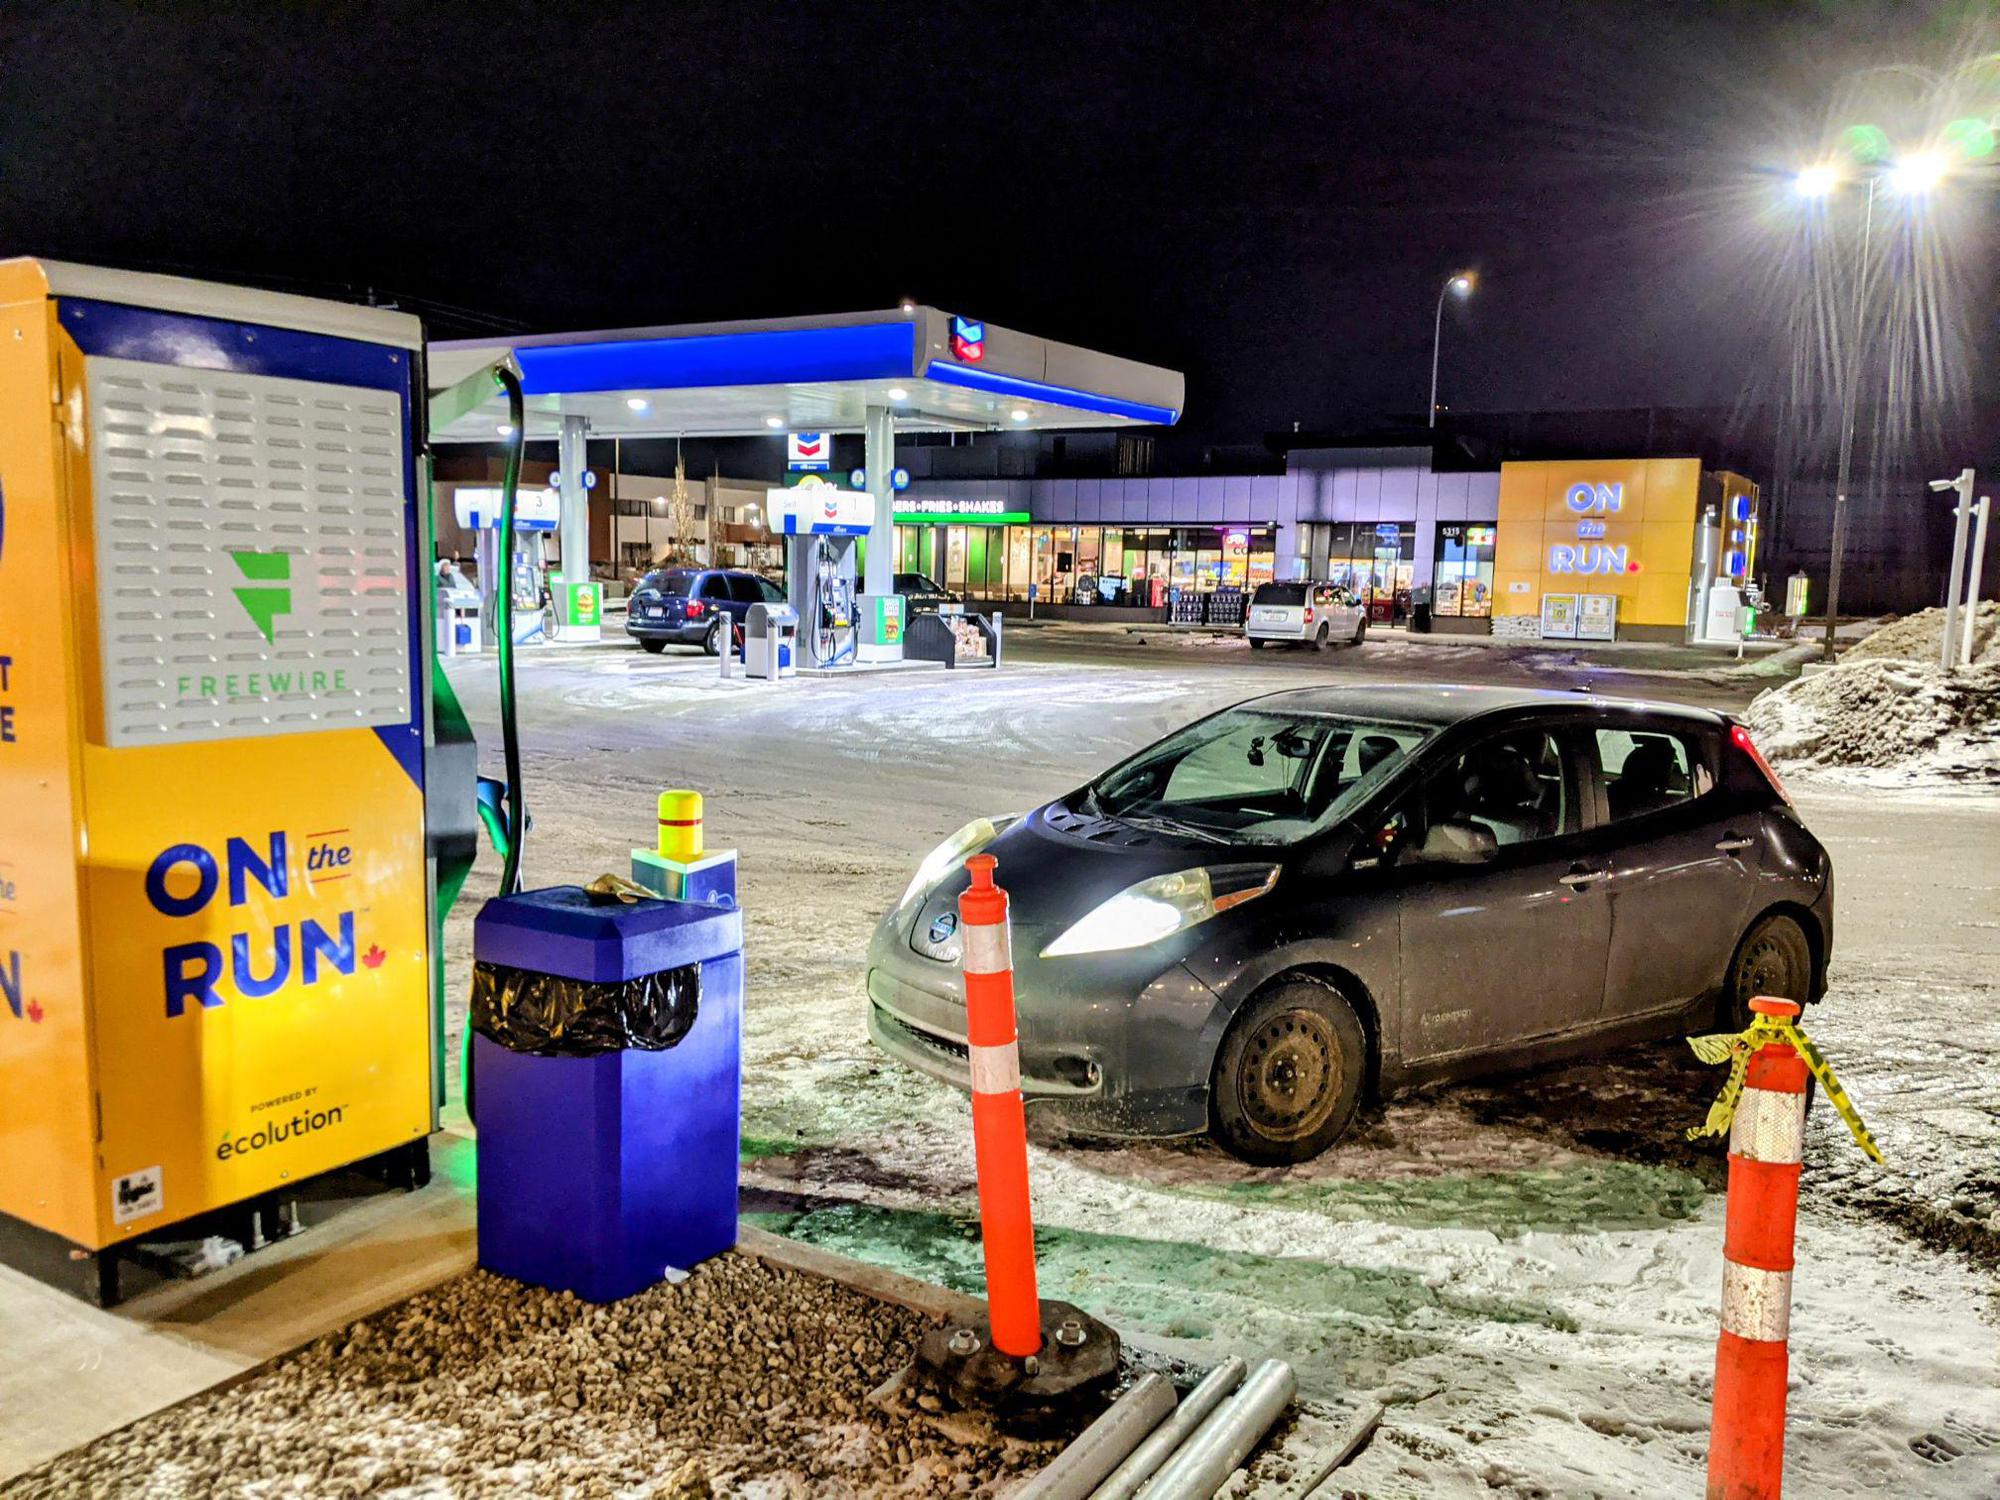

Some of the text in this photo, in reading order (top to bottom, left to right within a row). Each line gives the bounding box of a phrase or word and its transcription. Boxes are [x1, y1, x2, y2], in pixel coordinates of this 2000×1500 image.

[535, 496, 543, 508] 3
[921, 500, 953, 513] FRIES
[958, 500, 1004, 513] SHAKES
[1567, 482, 1623, 512] ON
[1549, 545, 1627, 575] RUN
[177, 669, 346, 696] FREEWIRE
[145, 830, 351, 917] ON the
[163, 911, 355, 1018] RUN
[251, 1086, 318, 1113] POWERED BY
[217, 1106, 342, 1161] écolution
